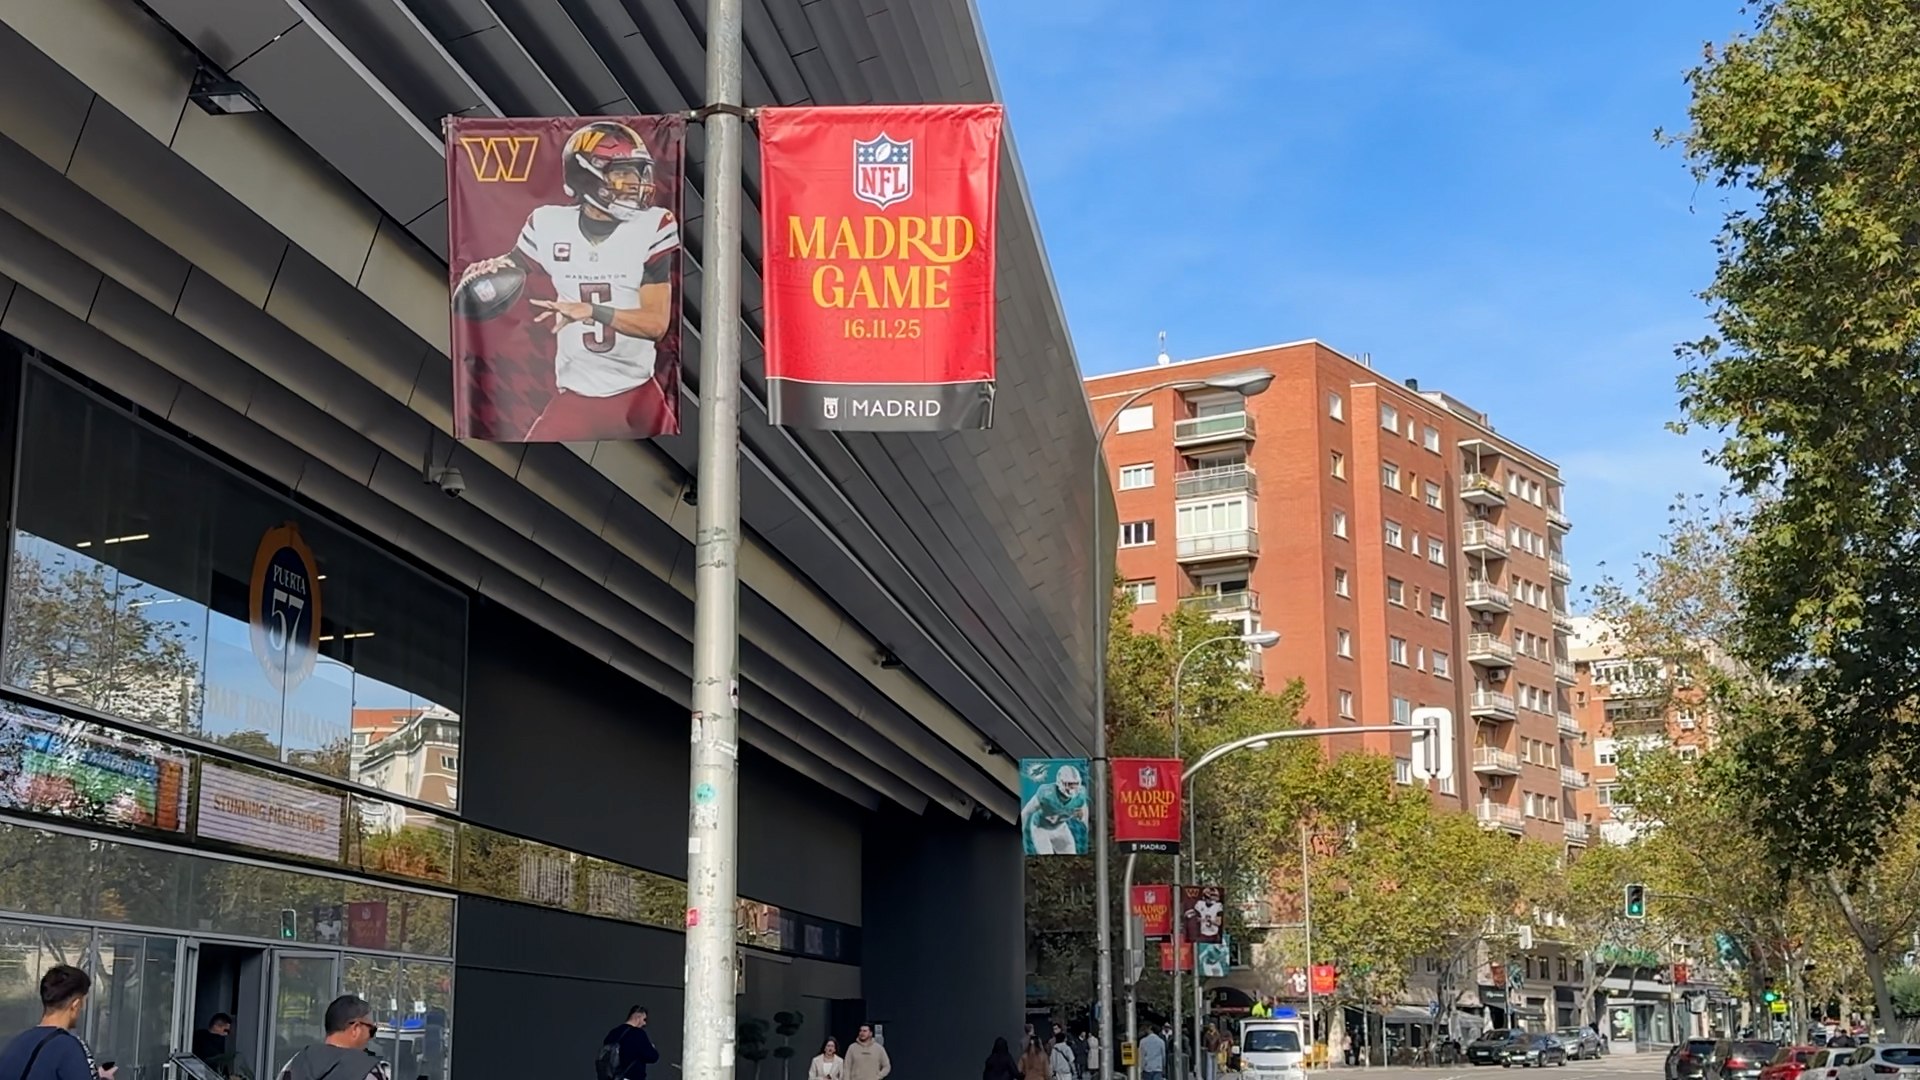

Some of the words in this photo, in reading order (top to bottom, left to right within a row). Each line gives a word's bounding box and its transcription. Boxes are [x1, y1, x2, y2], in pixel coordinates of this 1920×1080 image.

[860, 166, 906, 198] NFL
[788, 215, 975, 263] MADRID
[812, 264, 951, 309] GAME
[843, 318, 922, 339] 16.11.25
[852, 399, 942, 418] MADRID
[273, 563, 307, 596] PUERTA
[269, 587, 305, 657] 57
[1120, 789, 1176, 806] MADRID
[1127, 804, 1169, 819] GAME
[1139, 843, 1167, 851] MADRID
